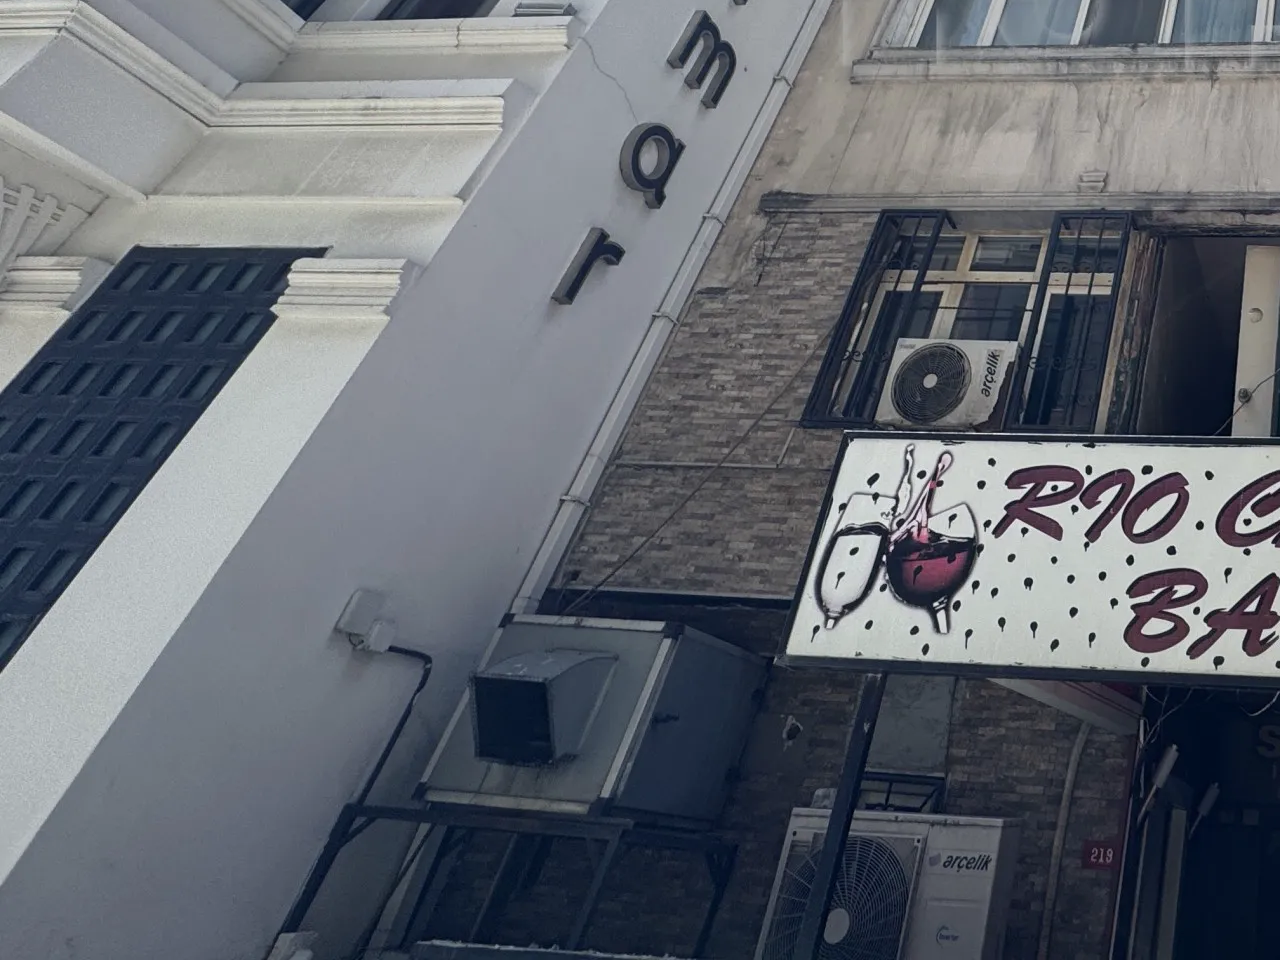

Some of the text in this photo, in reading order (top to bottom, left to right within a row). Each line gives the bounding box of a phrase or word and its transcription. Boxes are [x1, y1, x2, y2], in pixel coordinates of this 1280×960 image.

[981, 351, 1000, 397] arçelik
[993, 465, 1190, 544] RIO
[942, 854, 993, 873] arçelik
[1090, 847, 1114, 864] 219
